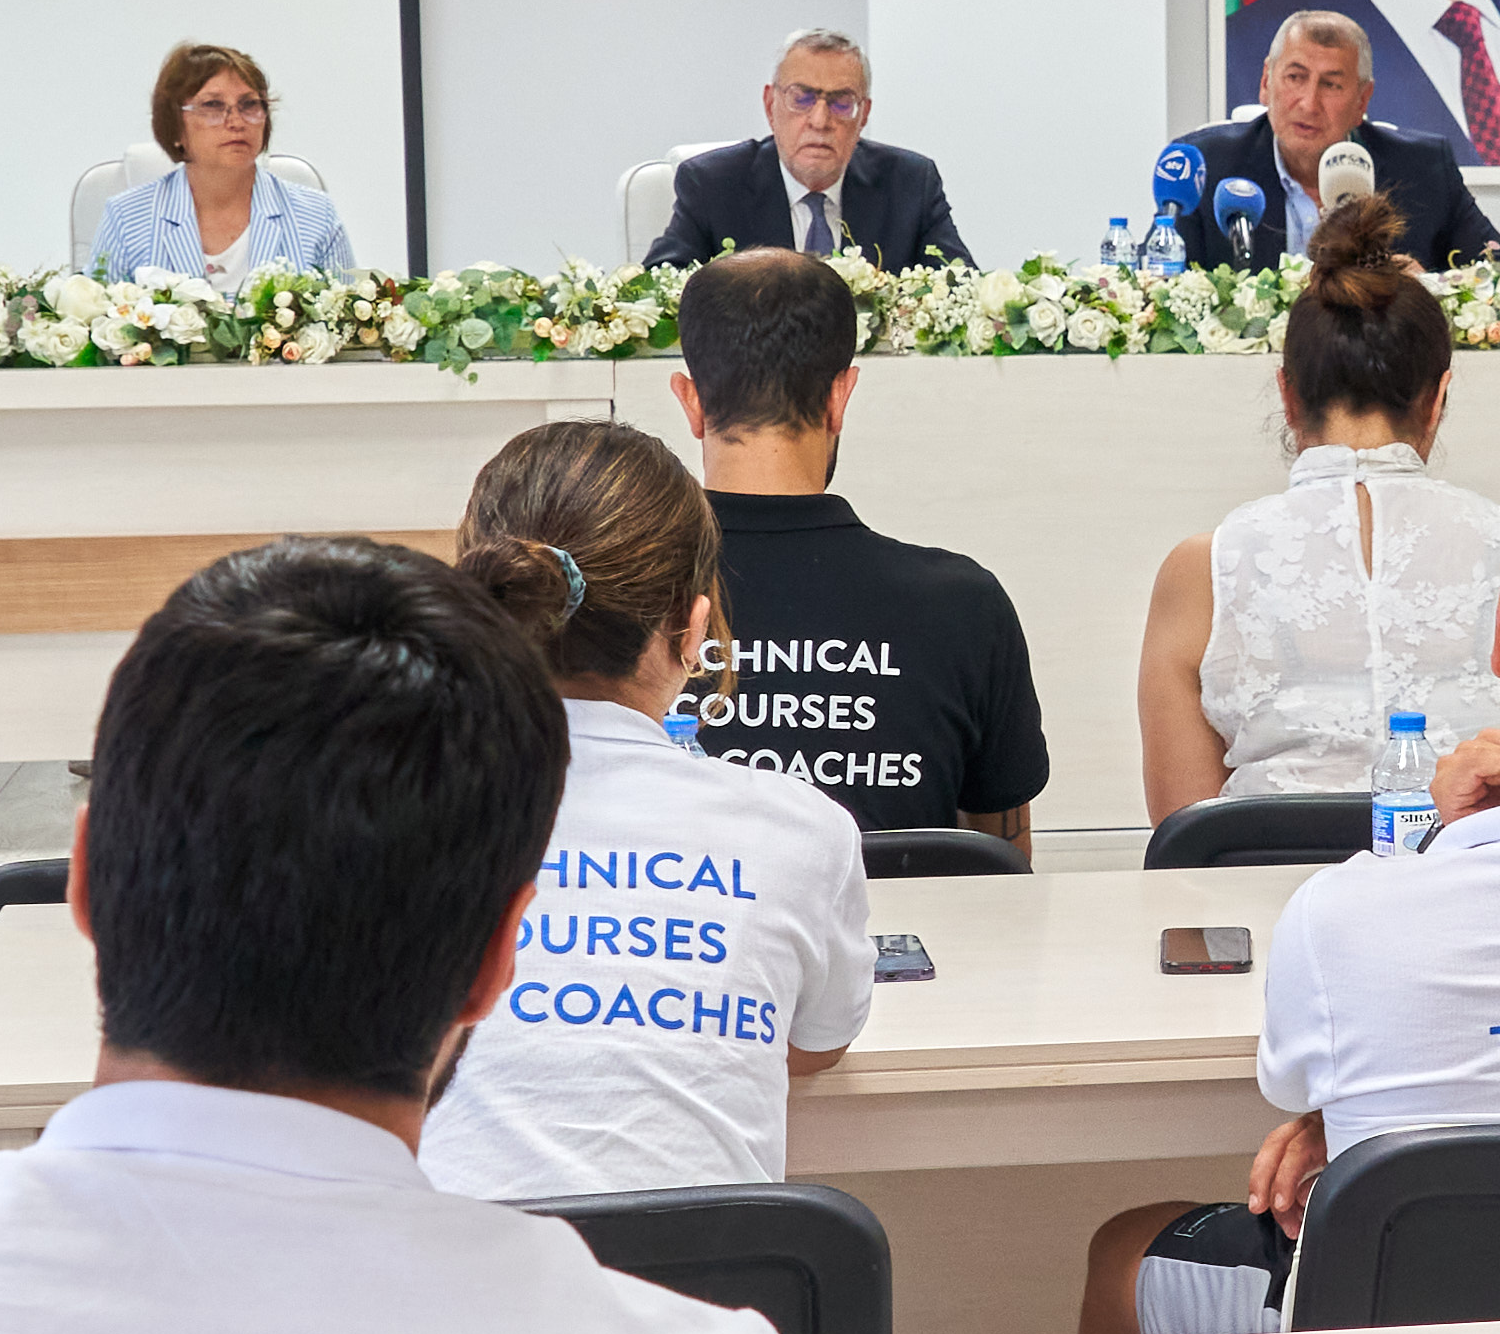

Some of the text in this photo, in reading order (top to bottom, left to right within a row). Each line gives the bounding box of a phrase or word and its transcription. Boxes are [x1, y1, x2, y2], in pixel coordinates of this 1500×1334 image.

[699, 639, 901, 676] CHNICAL
[538, 850, 757, 900] HNICAL
[510, 982, 777, 1044] COACHES
